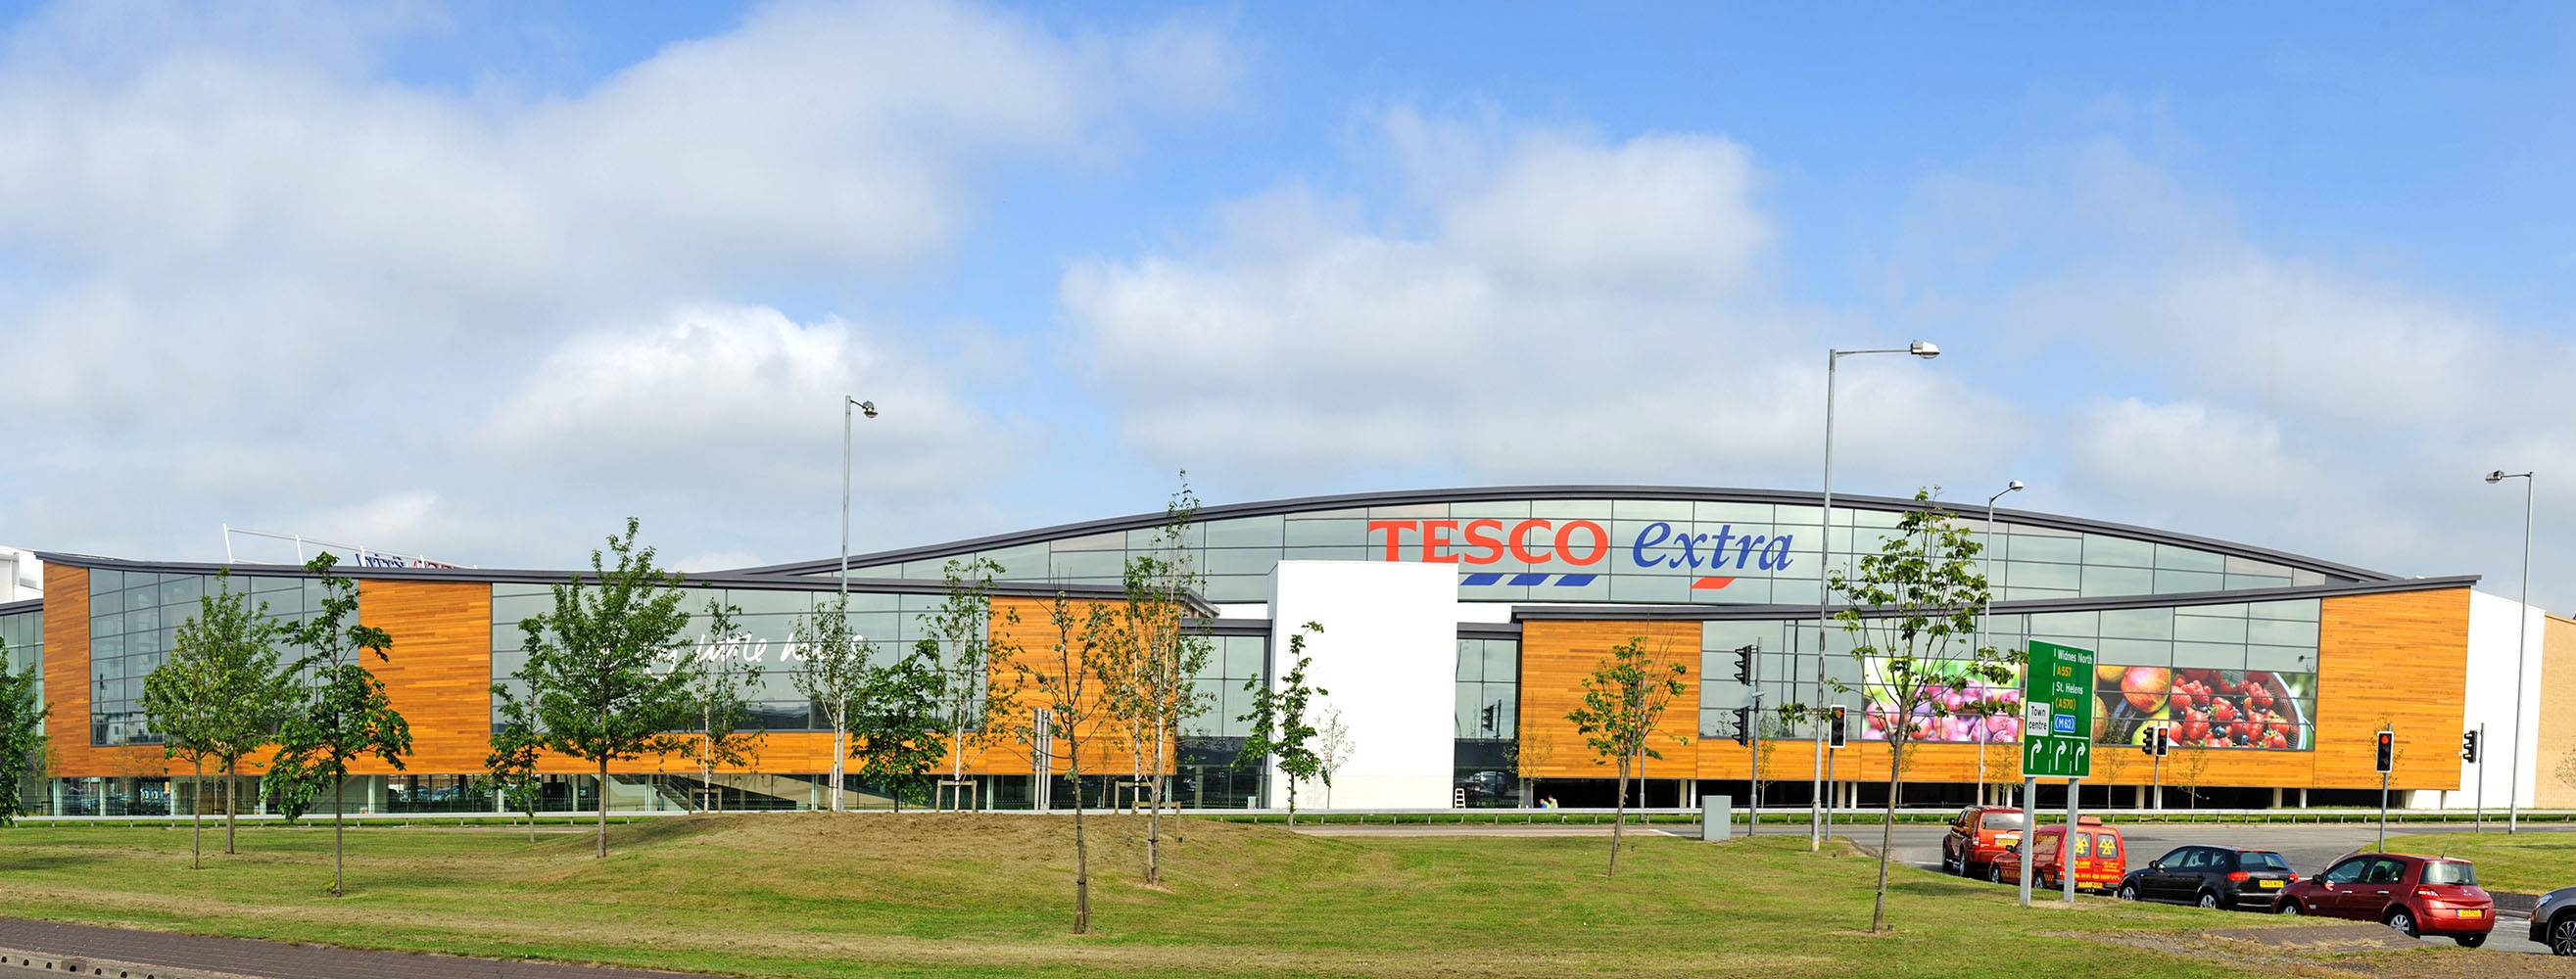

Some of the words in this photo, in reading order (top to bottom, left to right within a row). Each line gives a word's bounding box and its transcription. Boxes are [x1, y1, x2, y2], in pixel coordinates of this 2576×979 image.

[1368, 519, 1608, 566] TESCO
[1632, 522, 1793, 572] extra
[2057, 650, 2076, 662] Widnes
[2077, 653, 2092, 664] North
[2066, 682, 2083, 695] Helens
[2030, 706, 2046, 717] Town
[2028, 721, 2047, 730] centre
